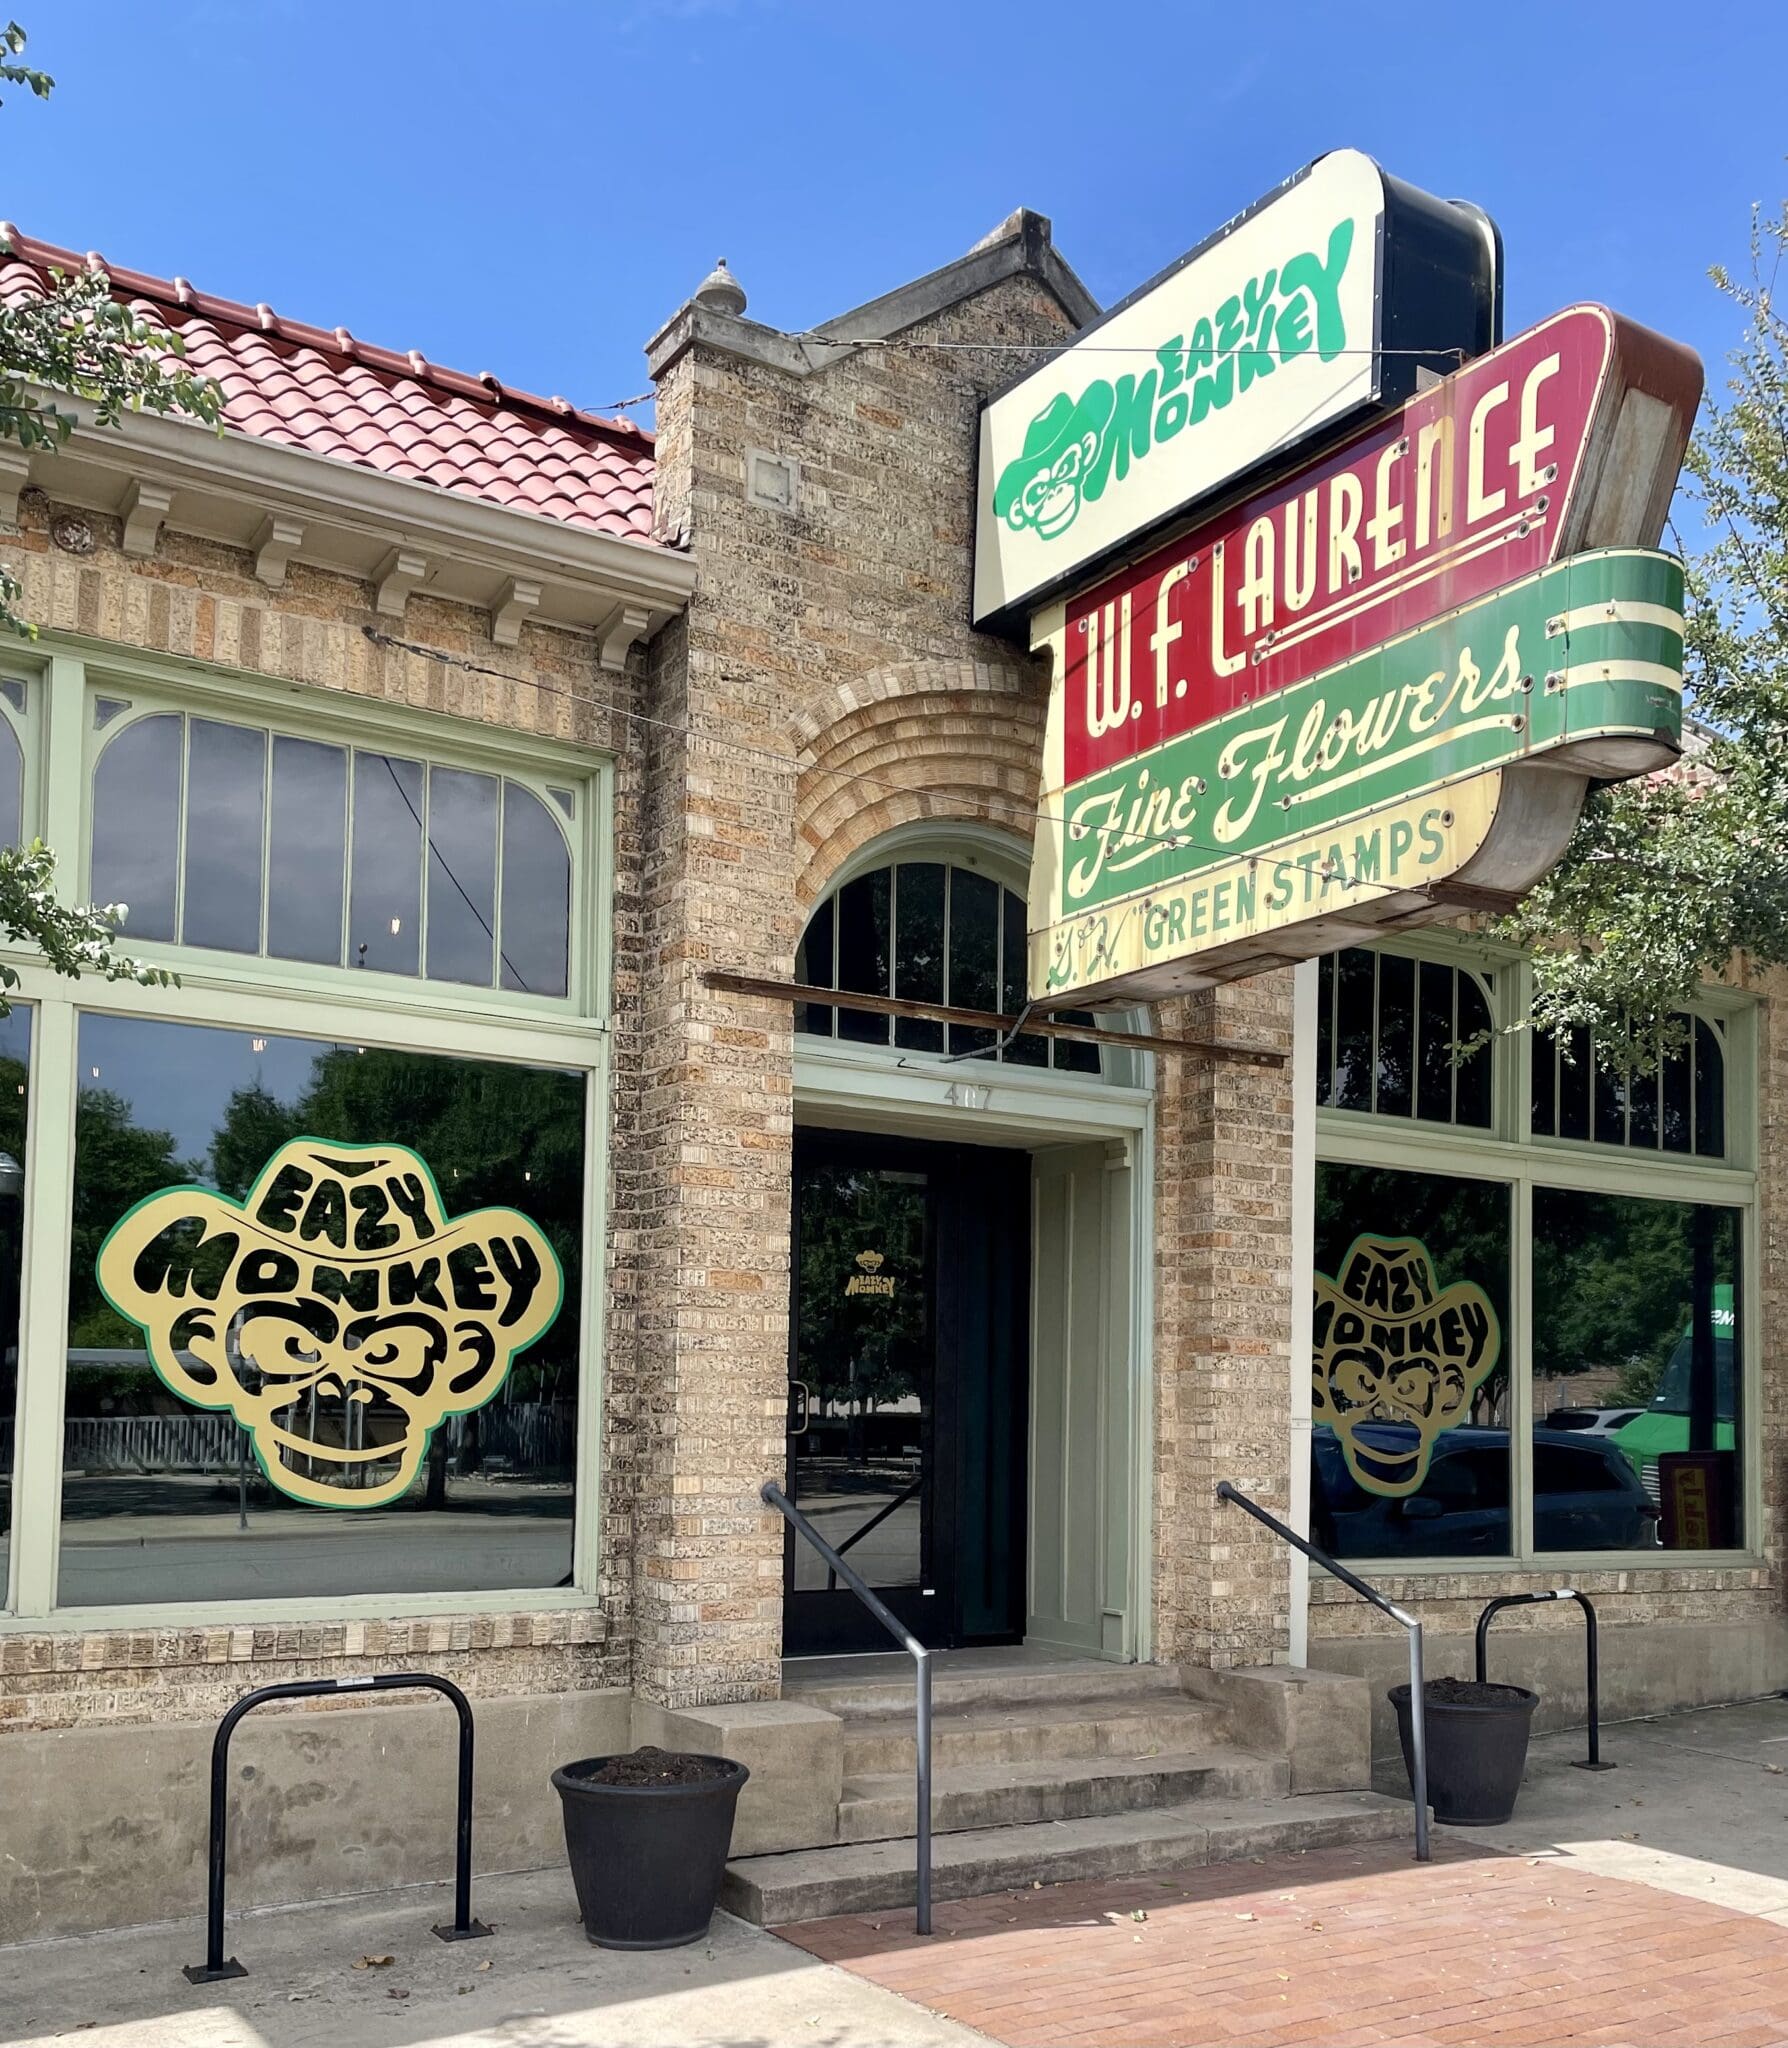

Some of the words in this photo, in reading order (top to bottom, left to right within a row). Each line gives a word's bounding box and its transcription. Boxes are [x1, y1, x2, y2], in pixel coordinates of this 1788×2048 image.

[1082, 217, 1354, 502] MONKEY
[1156, 268, 1278, 400] EAZY
[1211, 351, 1561, 678] LAURENCE
[1067, 768, 1198, 899] Fine
[1212, 624, 1528, 843] Flowers
[1143, 869, 1258, 951] GREEN
[1271, 808, 1446, 912] STAMPS
[943, 1082, 991, 1110] 407
[256, 1163, 436, 1252] EAZY
[133, 1215, 542, 1328] MONKEY
[844, 1275, 896, 1298] MONKEY
[1342, 1251, 1434, 1314] EAZY
